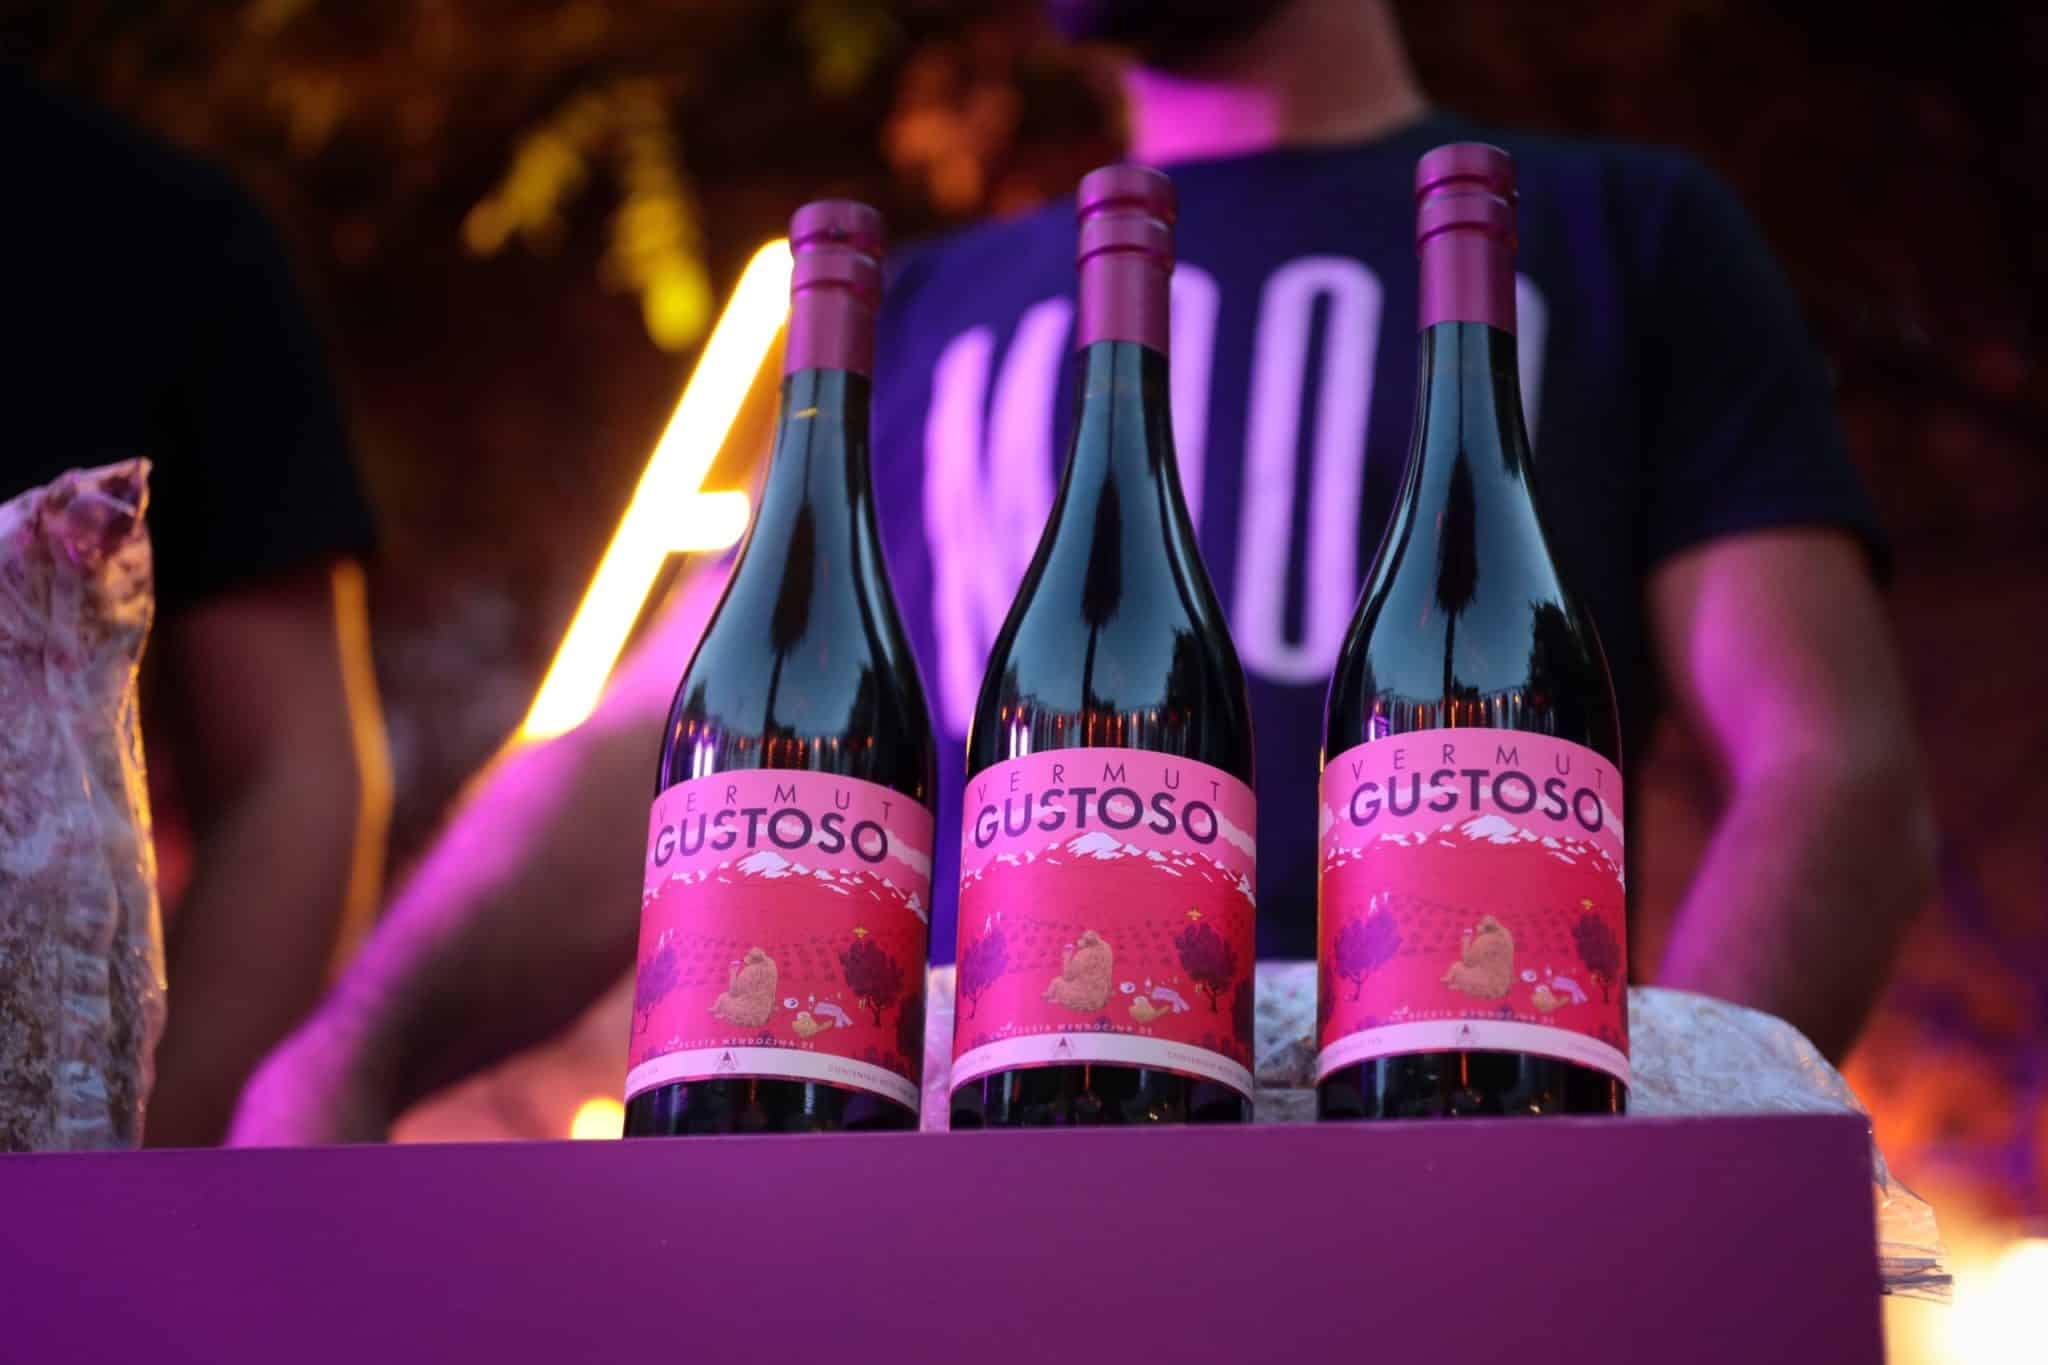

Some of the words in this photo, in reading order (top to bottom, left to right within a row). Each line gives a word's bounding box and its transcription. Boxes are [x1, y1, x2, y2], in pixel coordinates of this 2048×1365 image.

[977, 762, 1220, 802] VERMUT
[1351, 743, 1604, 788] VERMUT
[658, 783, 893, 825] VERMUT
[974, 786, 1218, 849] GUSTOSO
[1350, 768, 1604, 832] GUSTOSO
[653, 807, 888, 867] GUSTOSO
